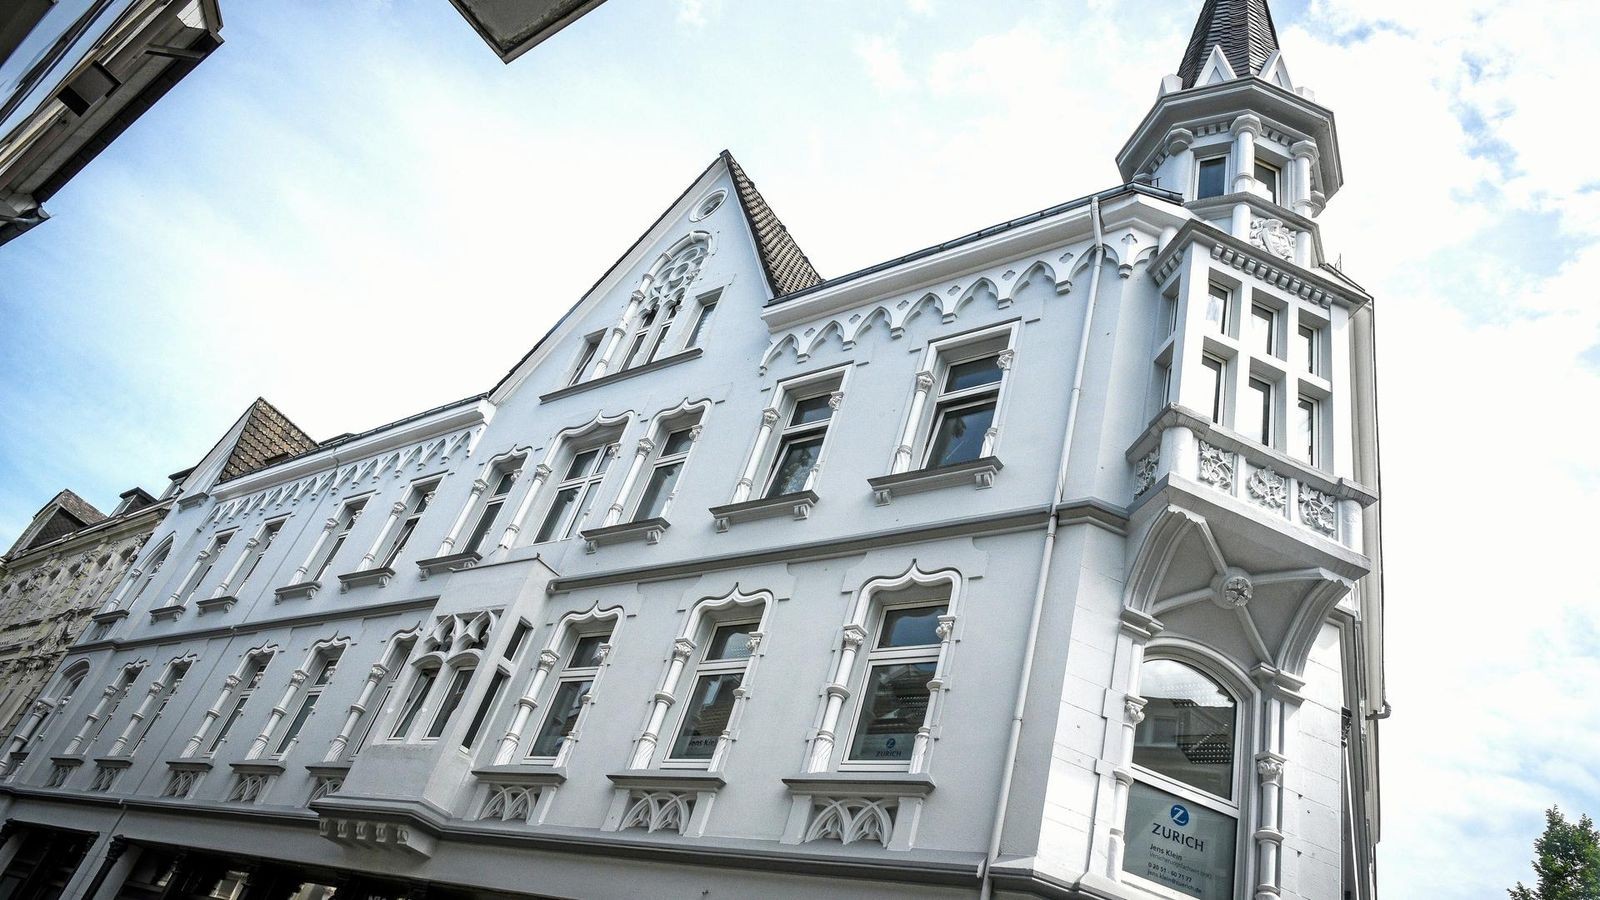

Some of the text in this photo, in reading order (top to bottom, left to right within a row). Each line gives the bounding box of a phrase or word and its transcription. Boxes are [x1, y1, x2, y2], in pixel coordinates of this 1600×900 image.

[1152, 823, 1204, 852] ZURICH
[1150, 843, 1183, 861] Jens Klein
